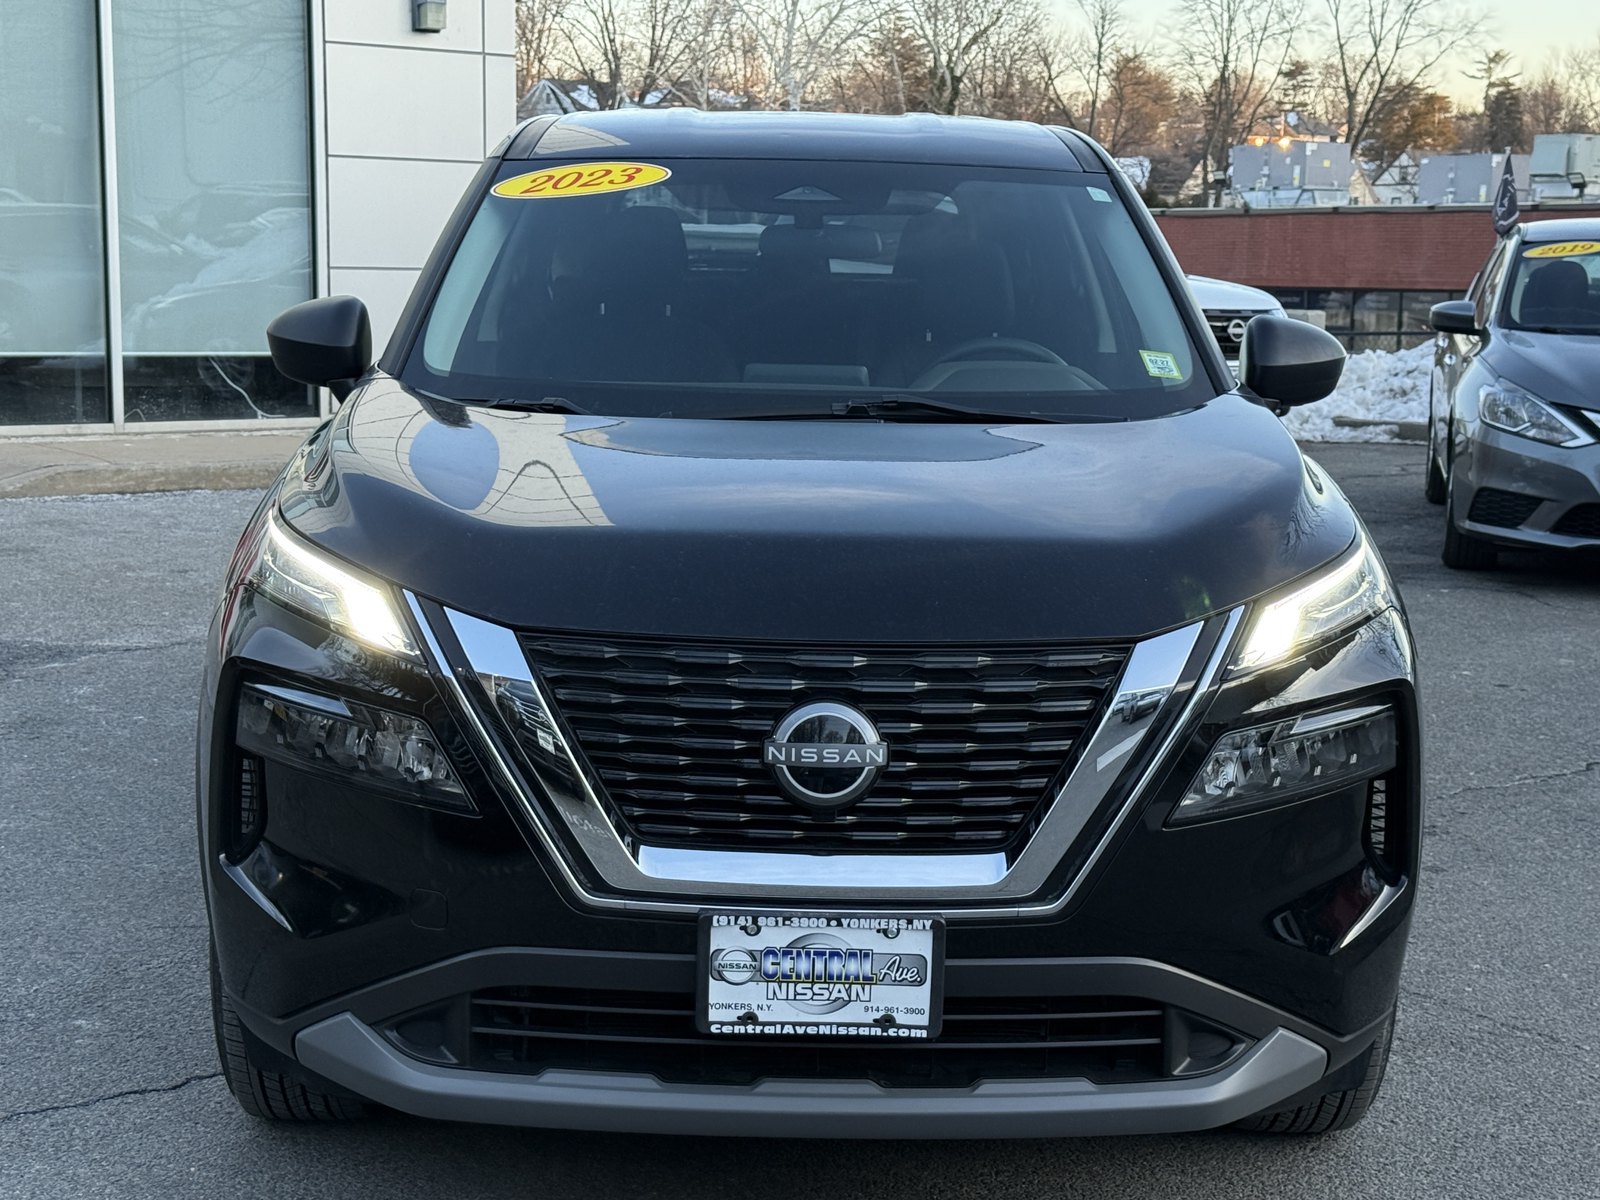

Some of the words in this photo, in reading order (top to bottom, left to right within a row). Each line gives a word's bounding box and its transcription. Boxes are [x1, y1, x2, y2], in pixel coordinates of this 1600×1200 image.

[519, 166, 643, 195] 2023
[1537, 243, 1595, 256] 2019
[768, 746, 883, 763] NISSAN
[757, 916, 828, 928] 961-3900
[717, 962, 757, 970] NISSAN
[761, 947, 877, 984] CENTRAL
[879, 955, 922, 982] Ave.
[766, 982, 871, 1002] NISSAN
[709, 1003, 755, 1012] YONKERS,
[863, 1005, 925, 1016] 914-961-3900
[710, 1024, 928, 1038] CentralAveNissan.com
